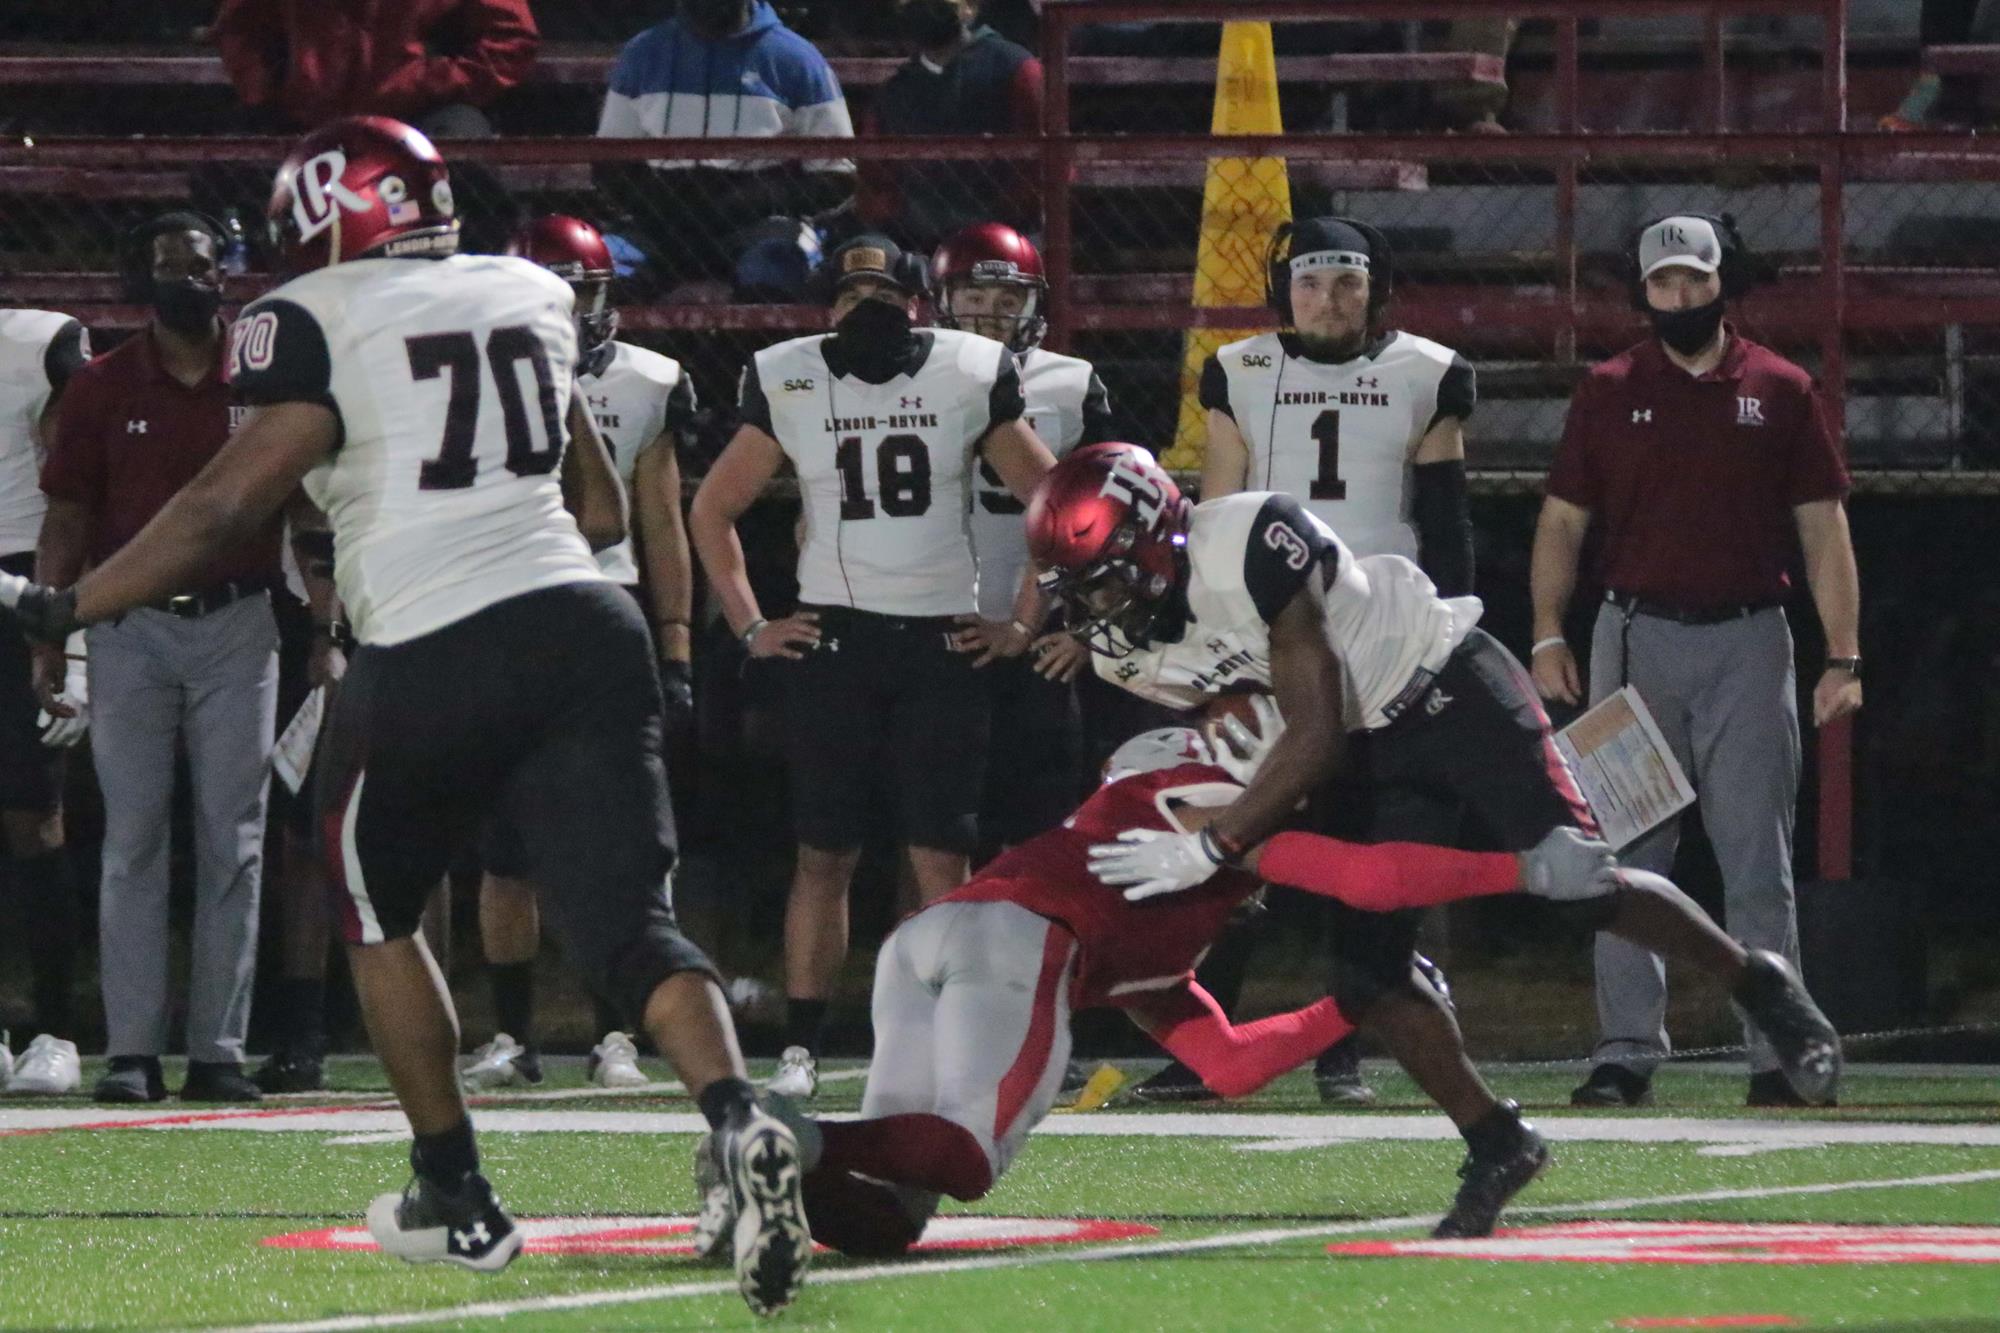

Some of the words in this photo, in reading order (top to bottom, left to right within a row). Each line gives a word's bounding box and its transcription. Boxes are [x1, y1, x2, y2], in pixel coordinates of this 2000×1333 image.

[1242, 354, 1272, 368] SAC
[784, 378, 815, 392] SAC
[1275, 391, 1389, 407] LENOIR-RHYNE
[404, 324, 563, 490] 70
[824, 413, 939, 433] LENOIR-RHYNE
[1309, 409, 1347, 501] 1
[835, 433, 932, 521] 18
[1264, 521, 1310, 570] 3
